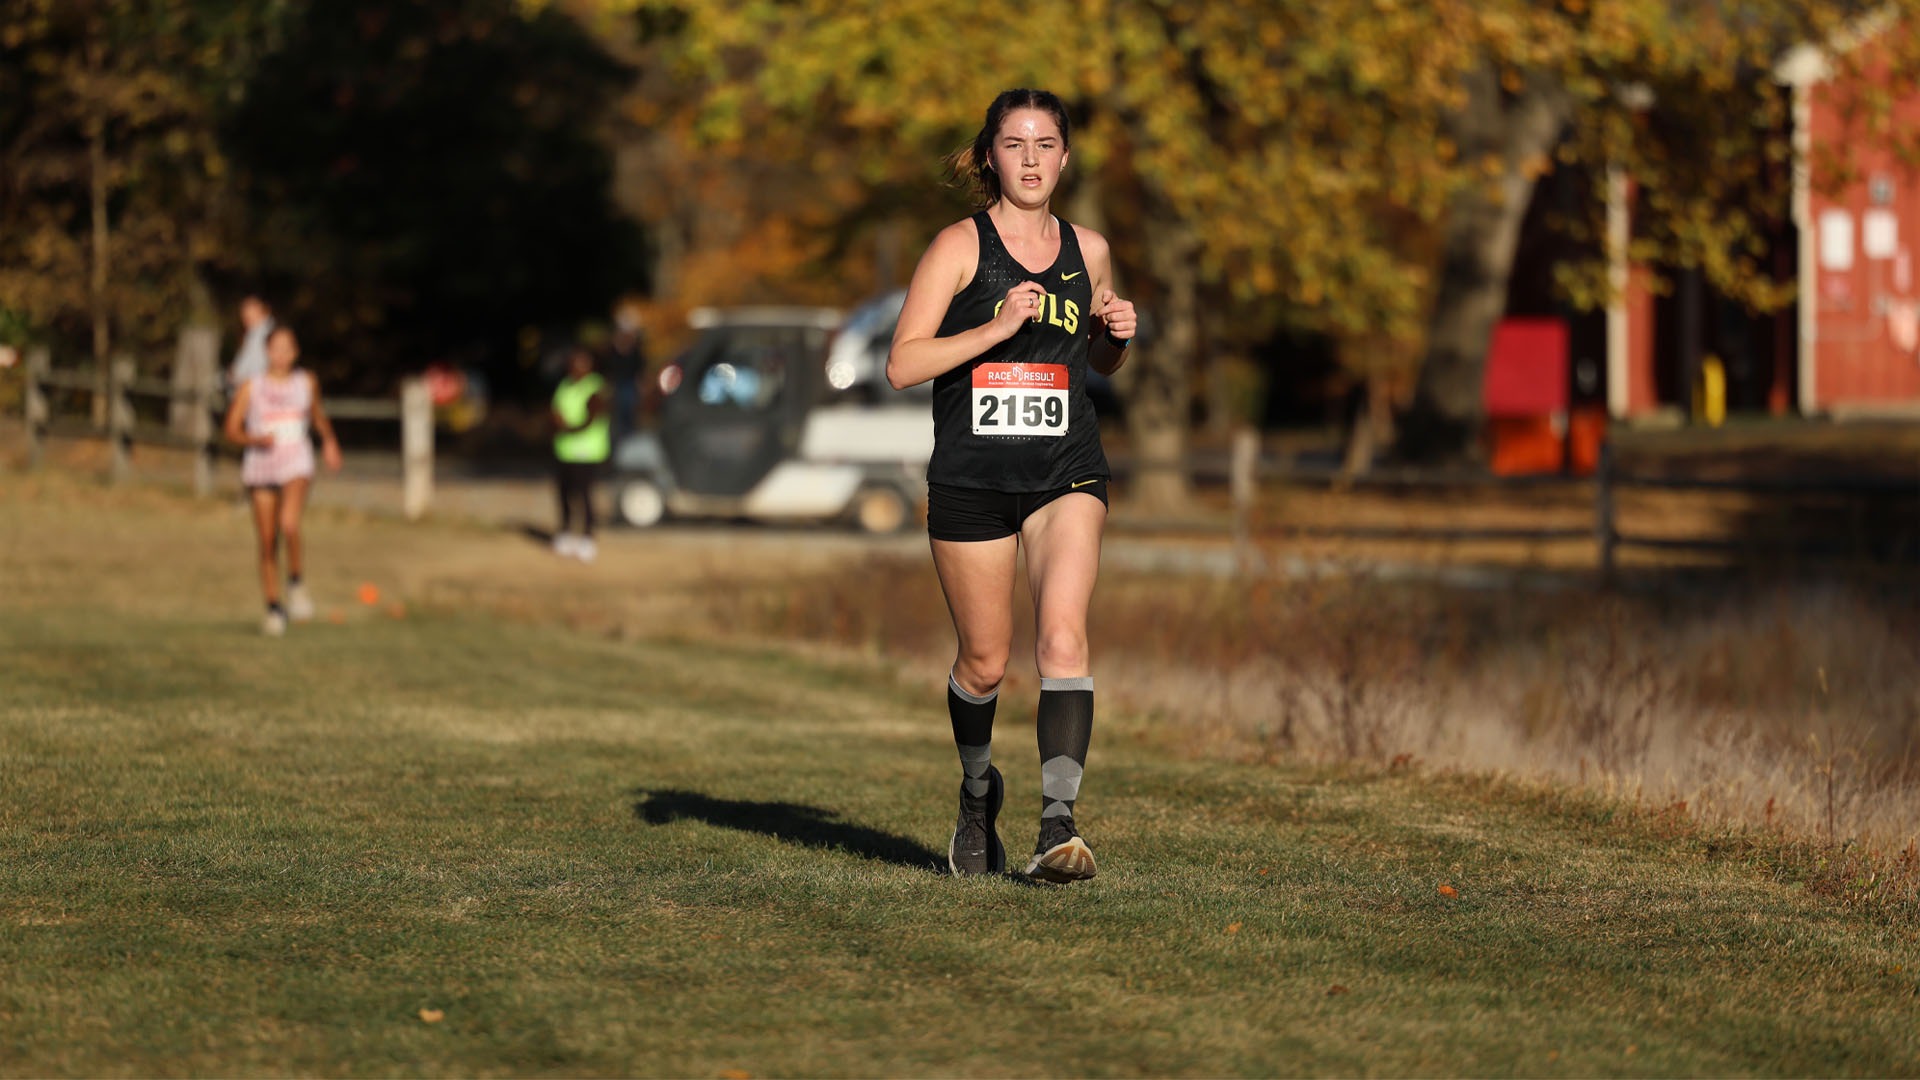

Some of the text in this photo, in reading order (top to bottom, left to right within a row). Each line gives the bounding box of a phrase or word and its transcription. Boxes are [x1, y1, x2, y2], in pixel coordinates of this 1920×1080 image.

[994, 292, 1079, 335] LS
[988, 372, 1055, 381] RACE RESULT
[979, 395, 1063, 428] 2159
